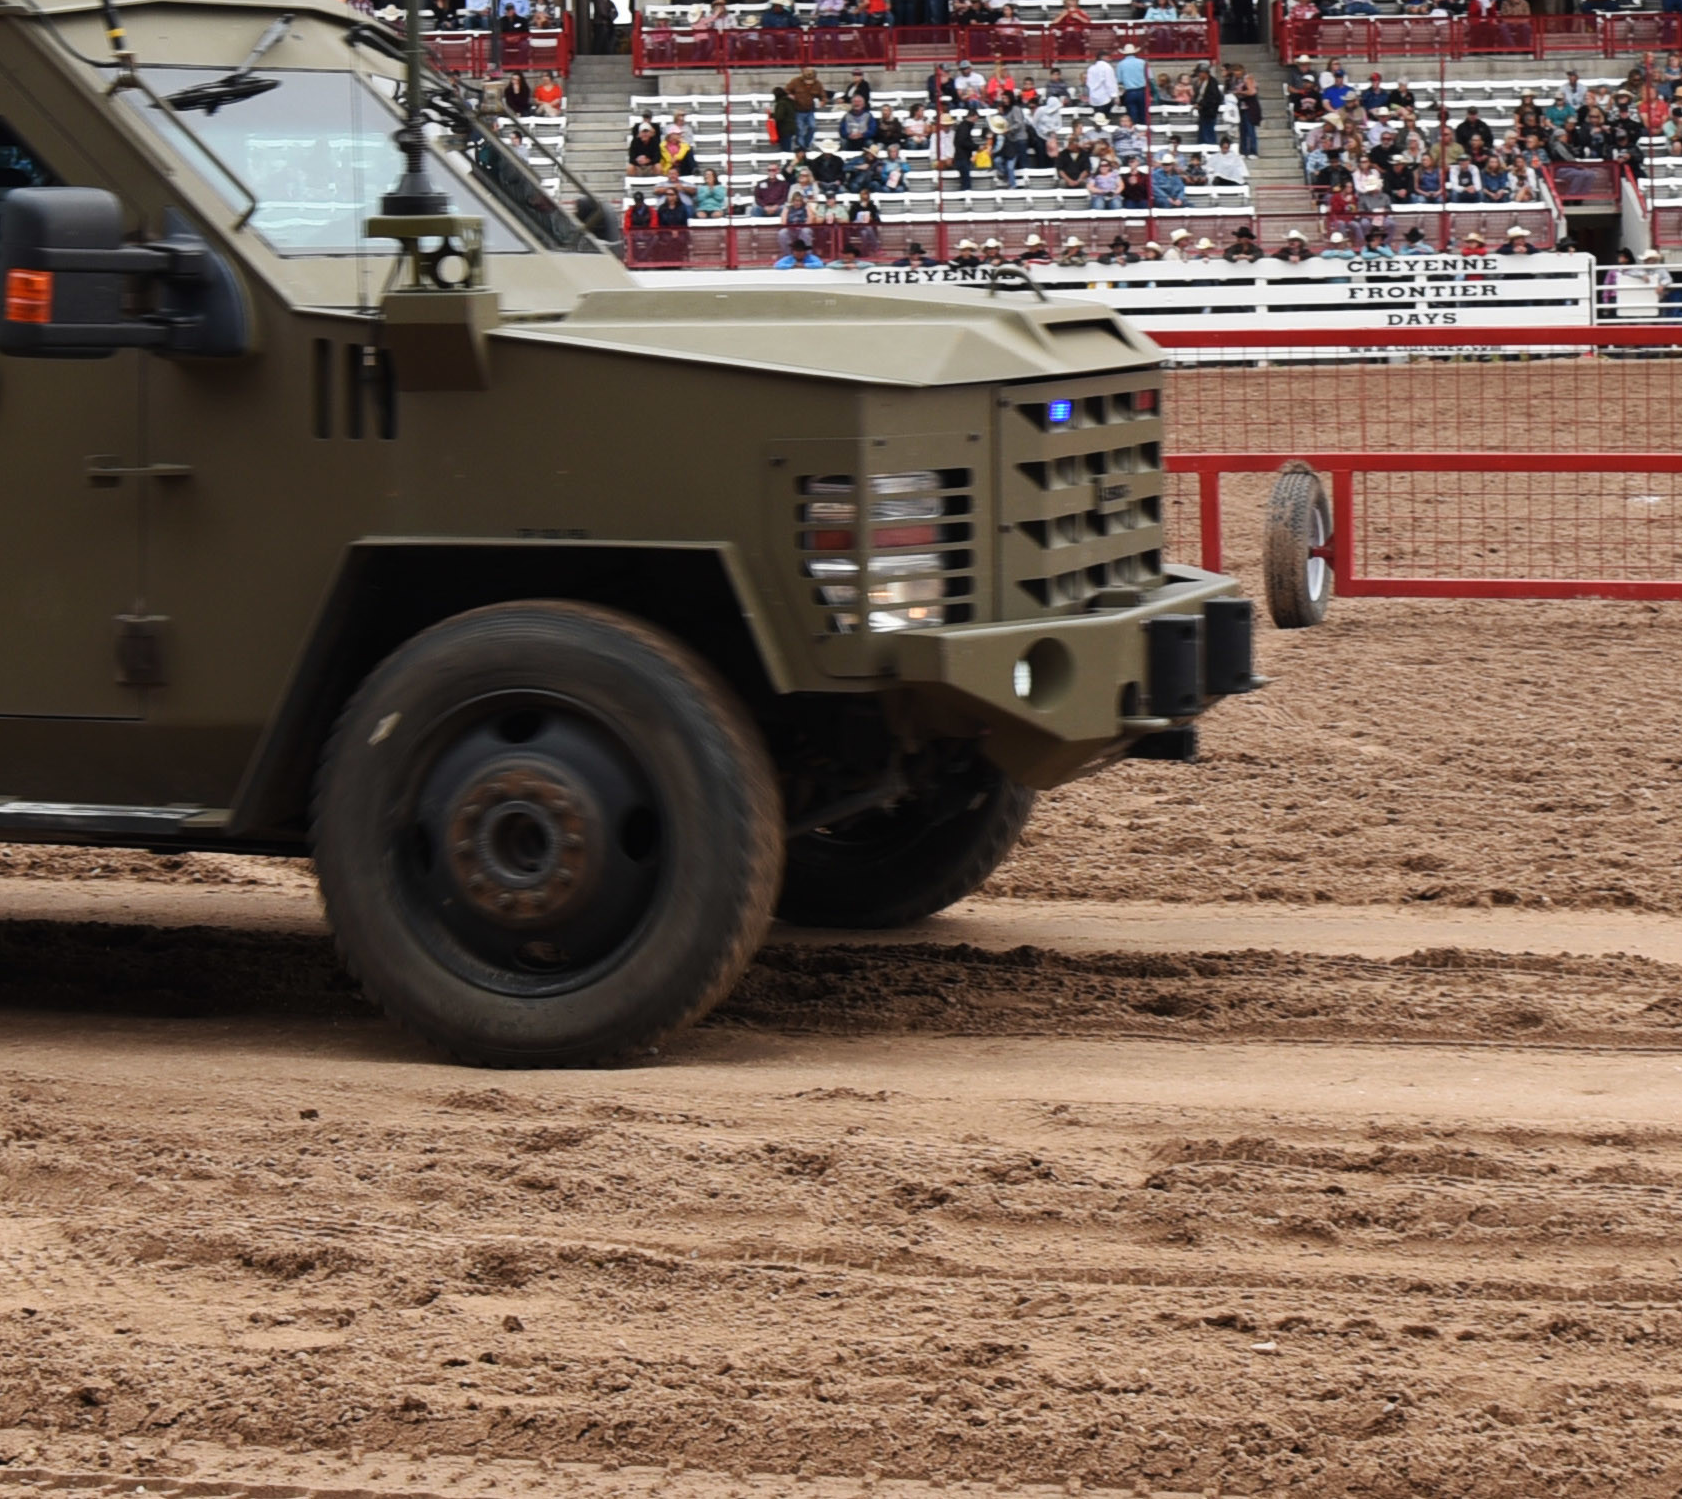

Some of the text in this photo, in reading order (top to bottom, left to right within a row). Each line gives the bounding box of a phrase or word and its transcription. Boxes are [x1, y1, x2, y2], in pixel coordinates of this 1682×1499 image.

[1347, 258, 1498, 273] CHEYENNE
[1348, 284, 1498, 300] FRONTIER
[1386, 312, 1458, 326] DAYS
